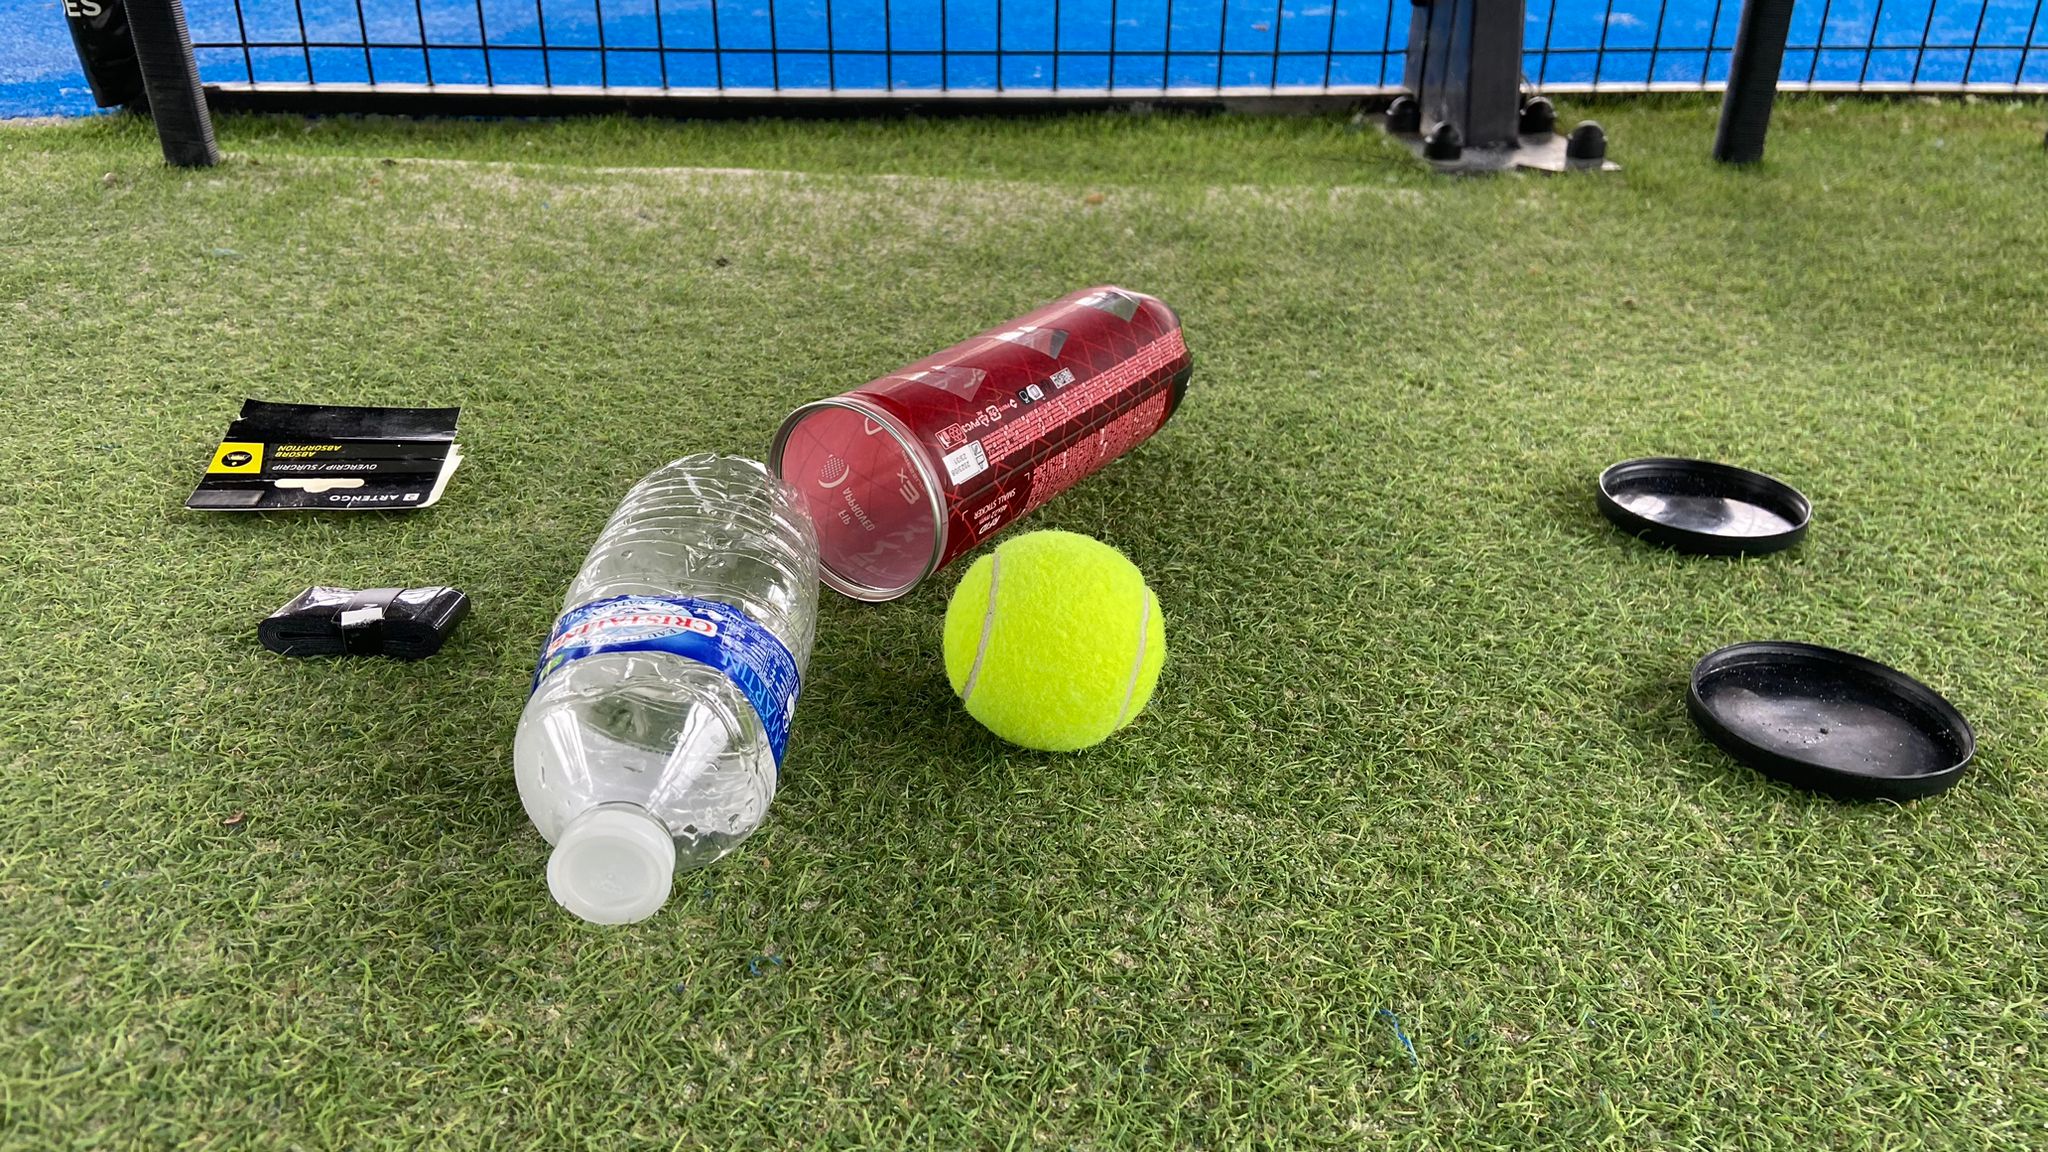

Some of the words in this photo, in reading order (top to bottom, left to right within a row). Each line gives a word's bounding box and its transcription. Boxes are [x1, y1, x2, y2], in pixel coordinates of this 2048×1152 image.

[61, 0, 102, 17] ES
[276, 444, 343, 452] ABSORPTION
[274, 450, 317, 459] ABSORB
[272, 463, 317, 471] SURGRIP
[327, 463, 378, 471] OVERGRIP
[329, 493, 399, 503] ARTENGO
[997, 487, 1015, 505] SMALL
[972, 498, 996, 520] STICKER
